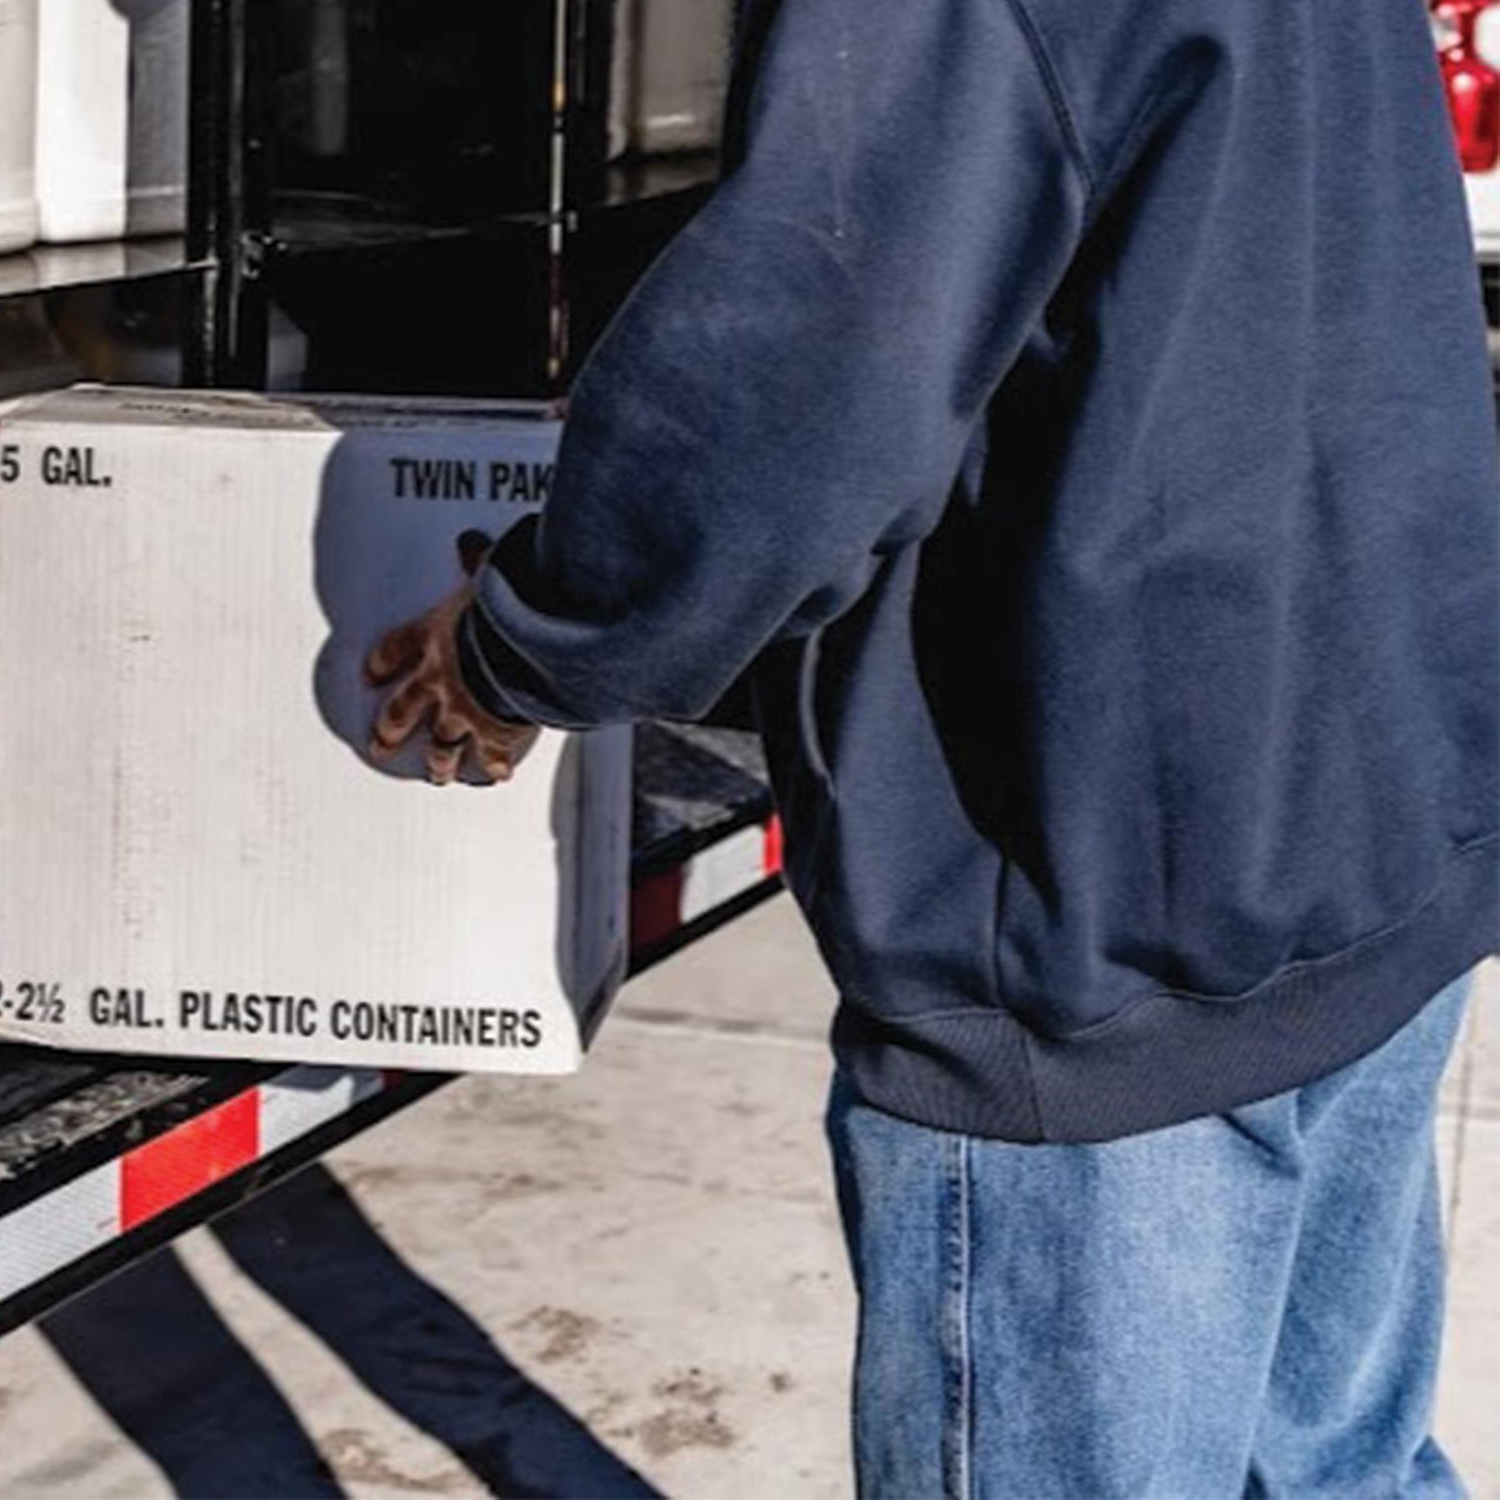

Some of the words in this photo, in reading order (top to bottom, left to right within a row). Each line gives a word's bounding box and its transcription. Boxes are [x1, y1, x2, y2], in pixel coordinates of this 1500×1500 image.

[0, 444, 20, 484] 5
[41, 445, 112, 487] GAL.
[389, 457, 477, 500] TWIN
[88, 986, 164, 1028] GAL.
[178, 990, 318, 1038] PLASTIC
[329, 999, 543, 1049] CONTAINERS
